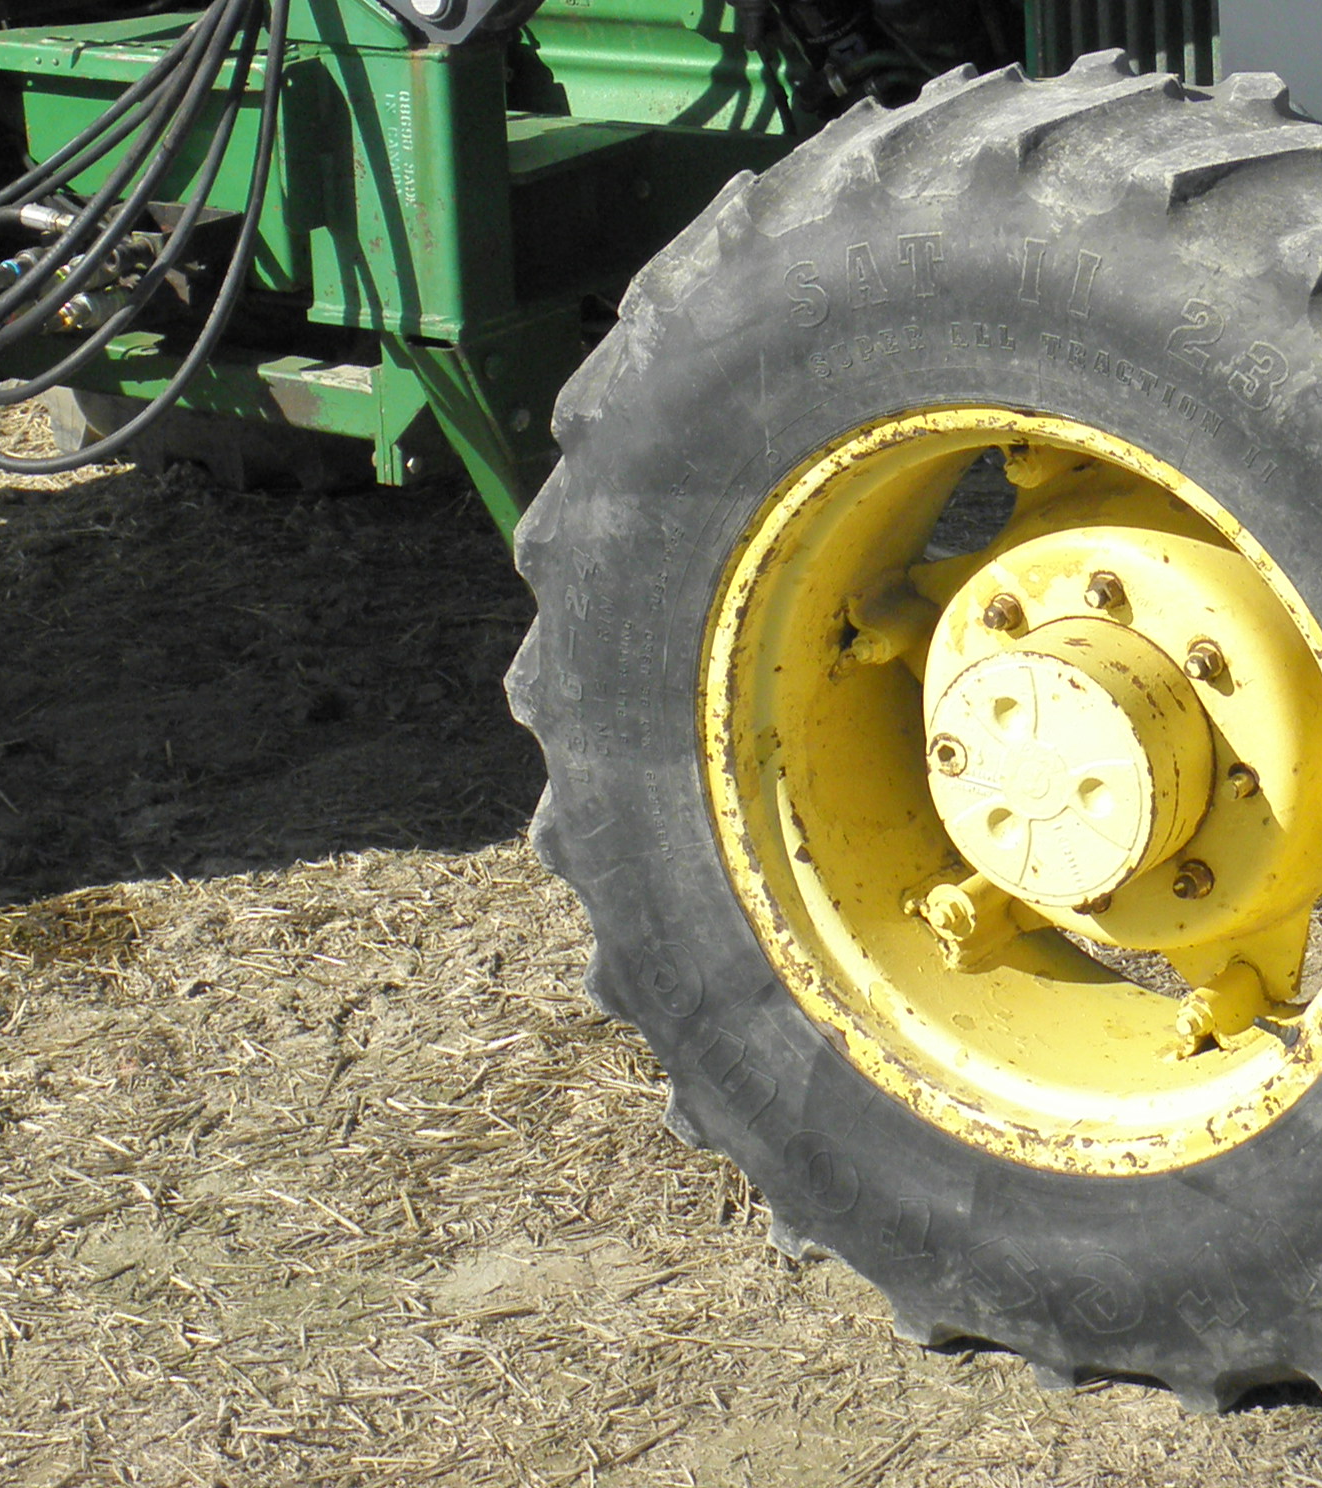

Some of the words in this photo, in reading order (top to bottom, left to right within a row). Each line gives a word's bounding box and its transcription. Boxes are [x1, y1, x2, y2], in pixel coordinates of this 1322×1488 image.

[781, 230, 949, 330] SAT
[805, 323, 928, 381] SUPER
[947, 320, 1015, 352] ALL
[1039, 330, 1229, 441] TRACTION
